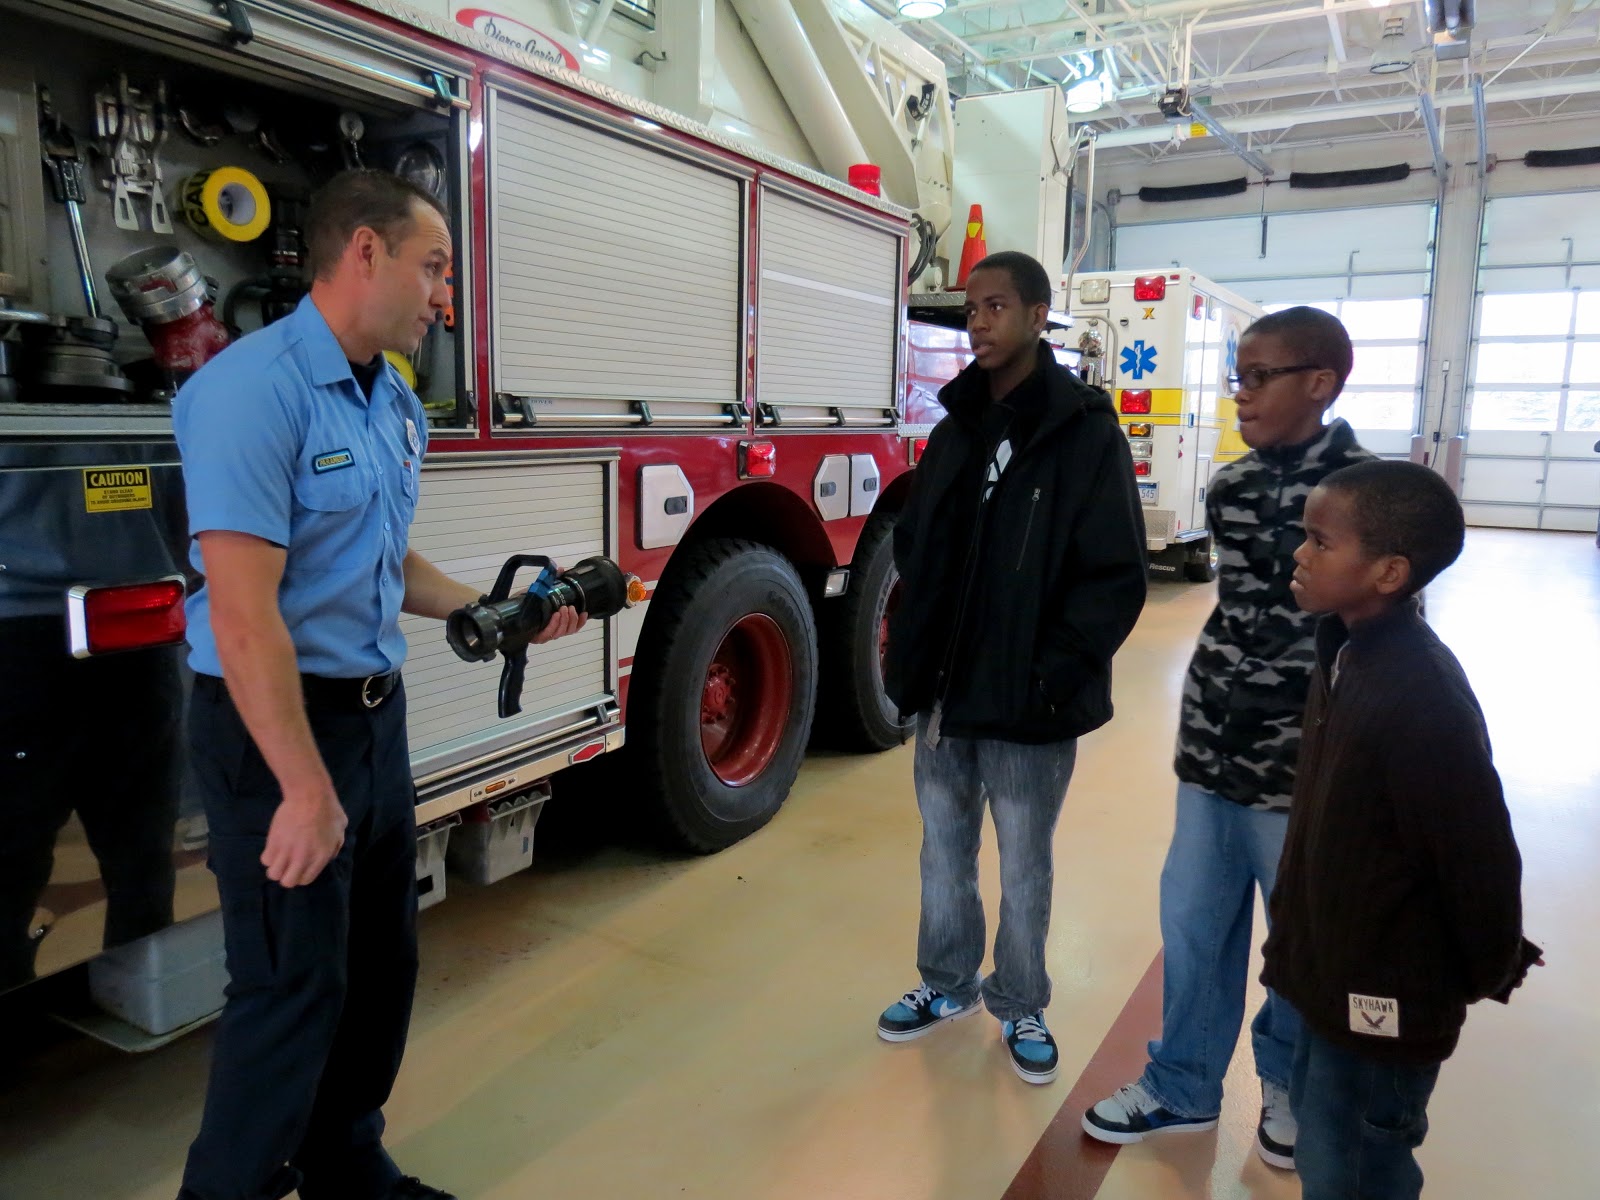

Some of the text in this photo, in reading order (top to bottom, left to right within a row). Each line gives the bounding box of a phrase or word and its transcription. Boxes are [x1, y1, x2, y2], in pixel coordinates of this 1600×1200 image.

[1142, 308, 1155, 319] X
[91, 472, 143, 486] CAUTION
[1149, 562, 1176, 572] Rescue
[1352, 996, 1394, 1013] SKYHAWK
